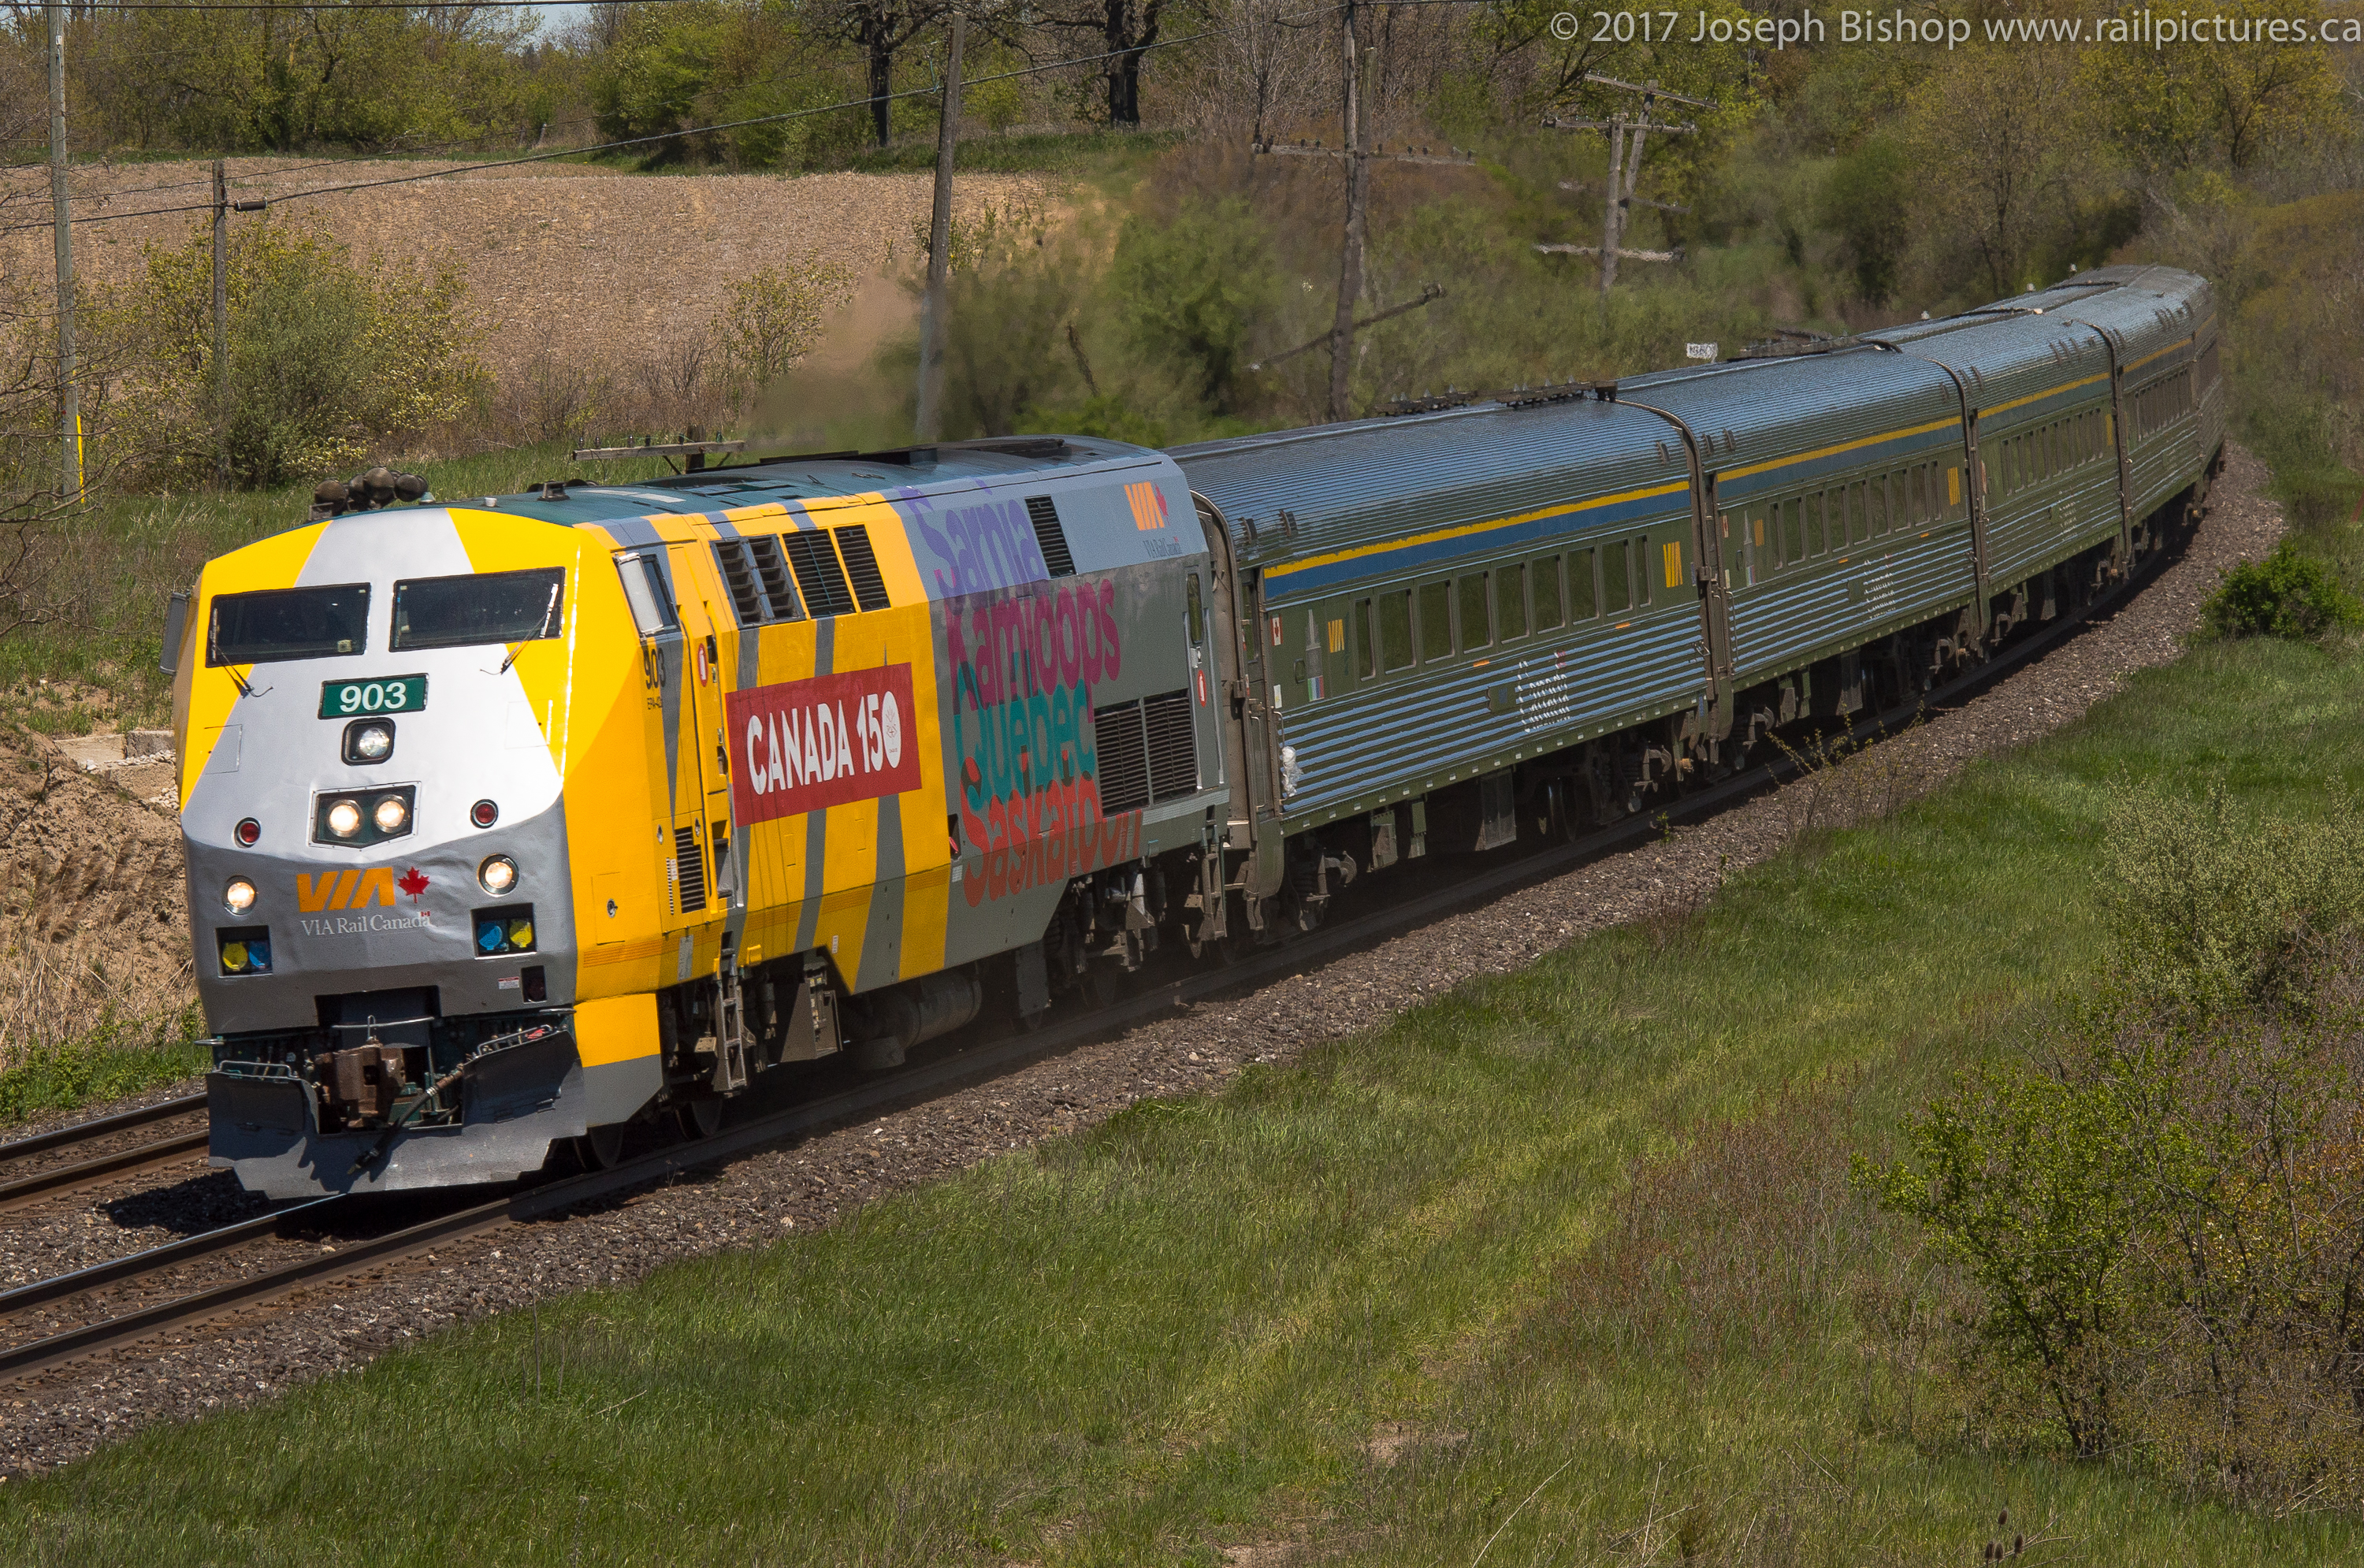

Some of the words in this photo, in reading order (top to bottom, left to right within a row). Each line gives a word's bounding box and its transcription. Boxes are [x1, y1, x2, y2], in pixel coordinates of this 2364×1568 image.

[1124, 481, 1165, 531] VIA
[894, 476, 1050, 616] Sarnia
[642, 648, 667, 690] 903
[943, 579, 1121, 723] Kamloops
[340, 682, 407, 712] 903
[747, 698, 855, 795] CANADA
[856, 690, 901, 773] 150
[296, 867, 396, 912] VIA
[301, 919, 335, 936] VIA
[336, 916, 368, 934] Rail
[370, 911, 433, 931] Canada
